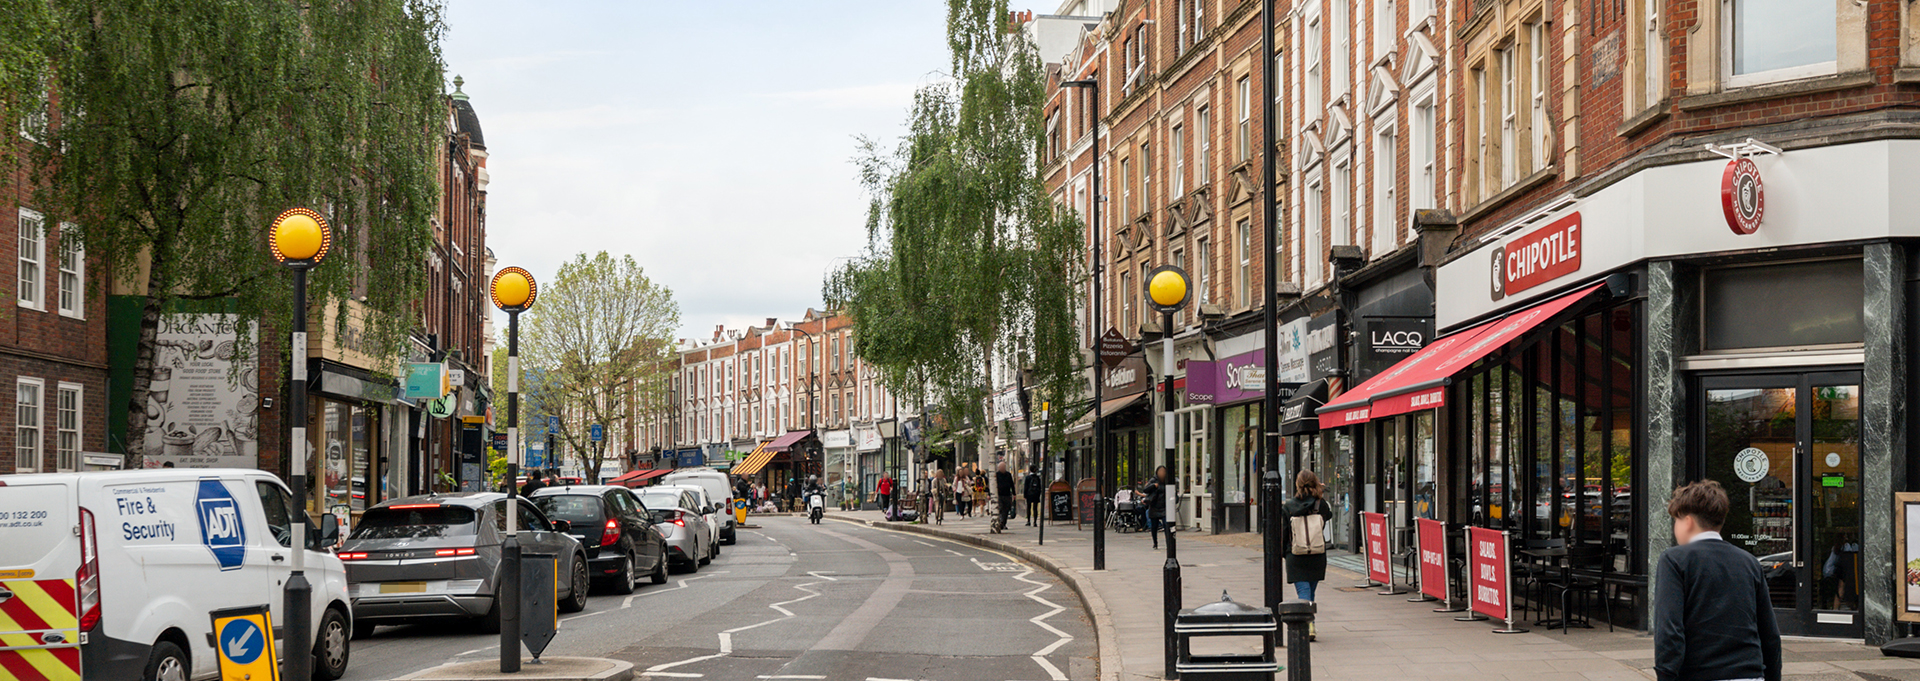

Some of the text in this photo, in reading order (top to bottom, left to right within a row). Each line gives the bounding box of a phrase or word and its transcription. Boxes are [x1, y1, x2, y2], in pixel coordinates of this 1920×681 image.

[1732, 161, 1763, 193] CHIPOTLE
[1507, 224, 1577, 283] CHIPOTLE
[1372, 330, 1422, 347] LACQ
[1189, 392, 1213, 401] Scope
[1736, 448, 1768, 464] CHIPOTLE
[12, 511, 28, 520] 132
[30, 510, 47, 519] 200
[116, 496, 157, 516] Fire &
[122, 520, 175, 541] Security
[208, 506, 237, 540] ADT
[1479, 540, 1497, 560] SALADS.
[1480, 562, 1497, 583] BOWLS.
[1478, 584, 1500, 607] BURRITOS.
